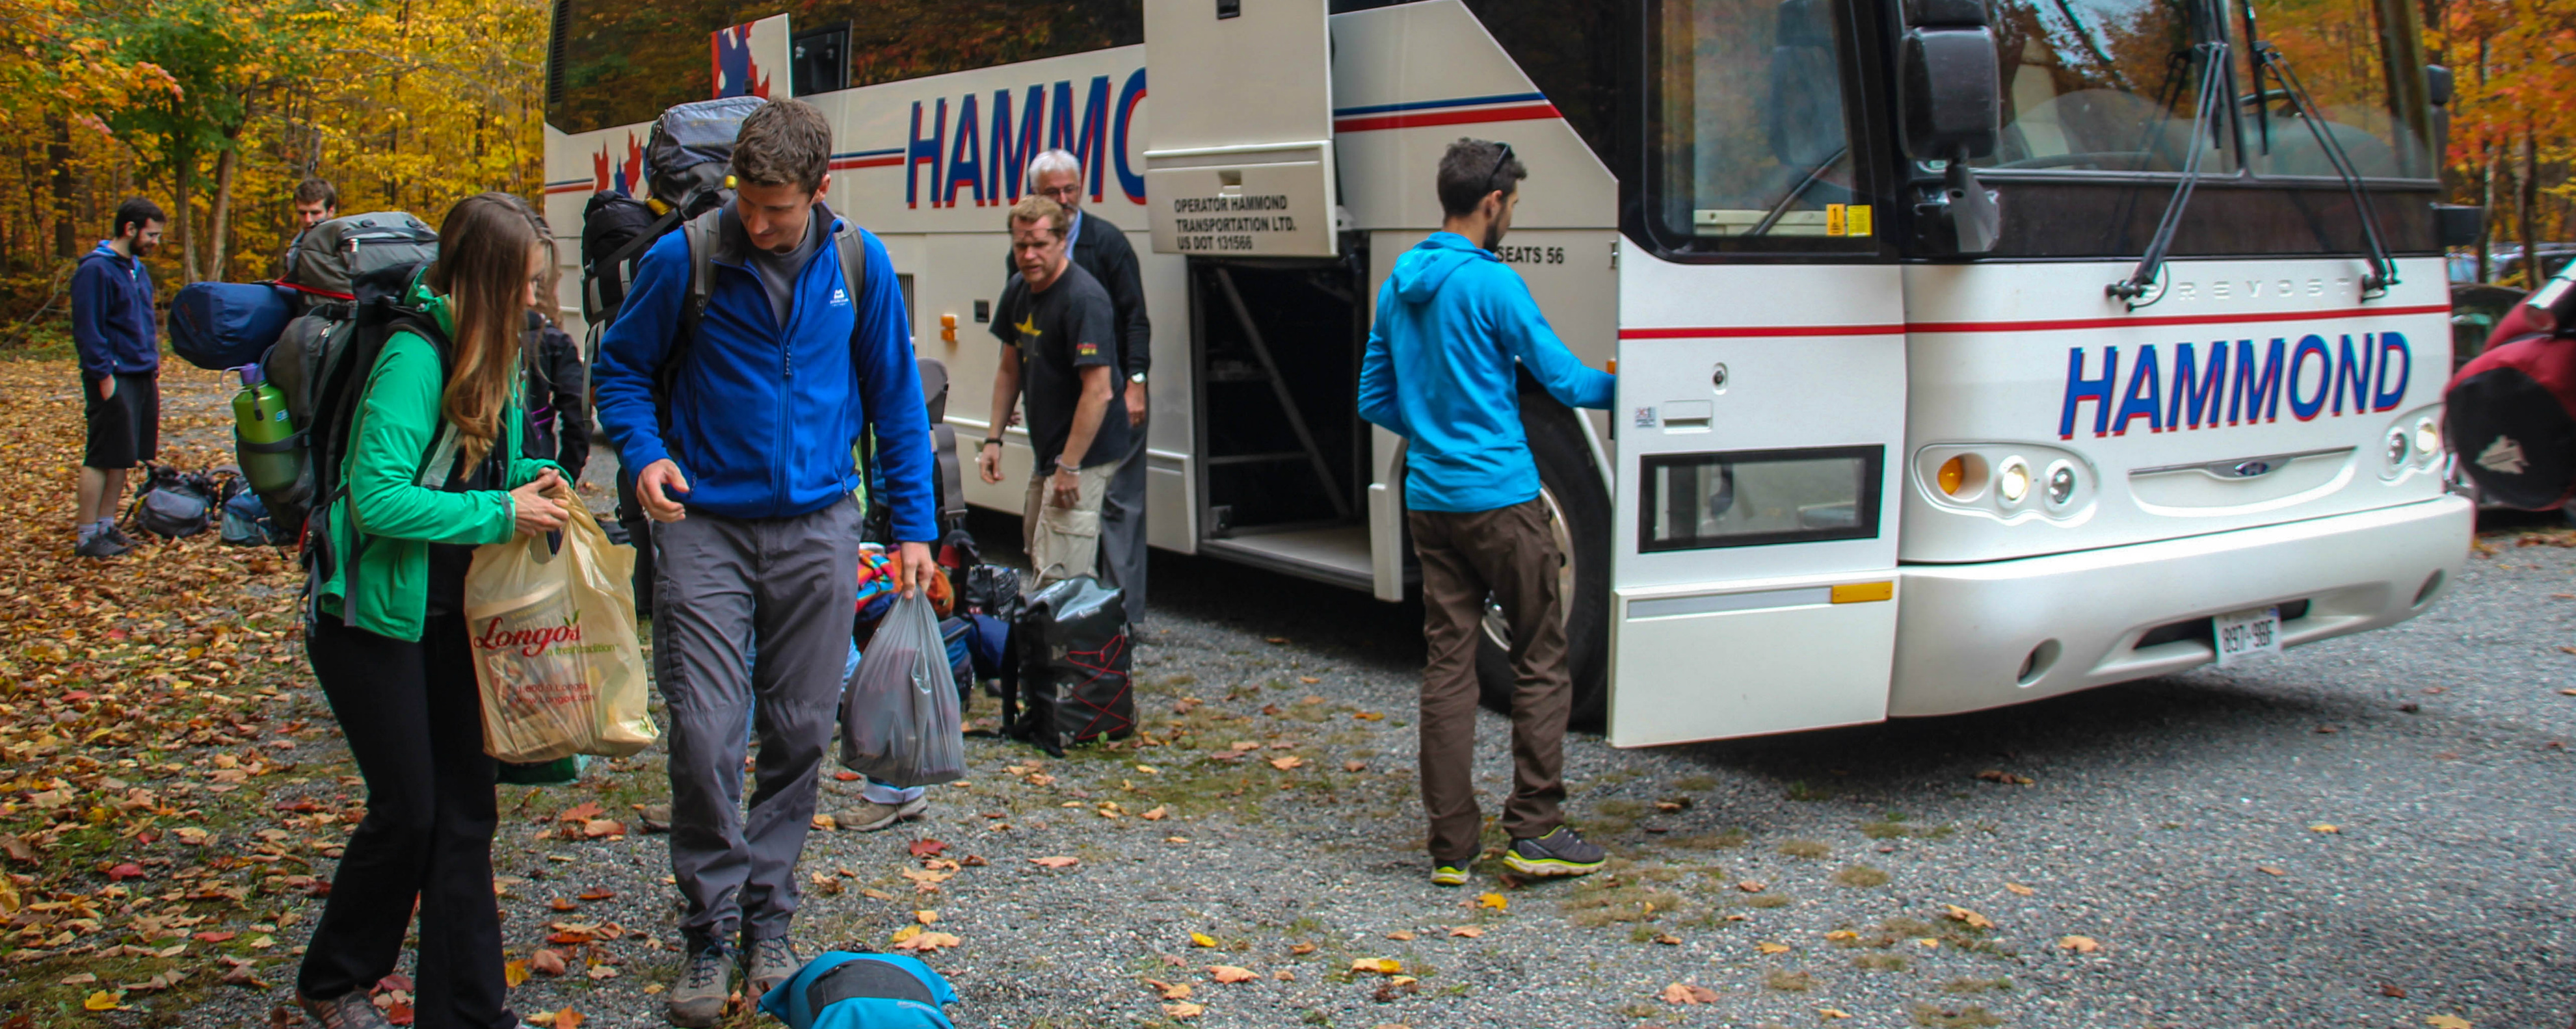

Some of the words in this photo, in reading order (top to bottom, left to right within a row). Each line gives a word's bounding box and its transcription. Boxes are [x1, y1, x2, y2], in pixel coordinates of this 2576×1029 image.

[1175, 198, 1228, 213] OPERATOR
[1231, 195, 1288, 211] HAMMOND
[1176, 218, 1269, 233] TRANSPORTATION
[1272, 216, 1297, 231] LTD.
[1177, 236, 1191, 250] US
[1193, 236, 1213, 250] DOT
[1497, 246, 1542, 263] SEATS
[1547, 246, 1565, 264] 56
[2058, 332, 2411, 440] HAMMOND
